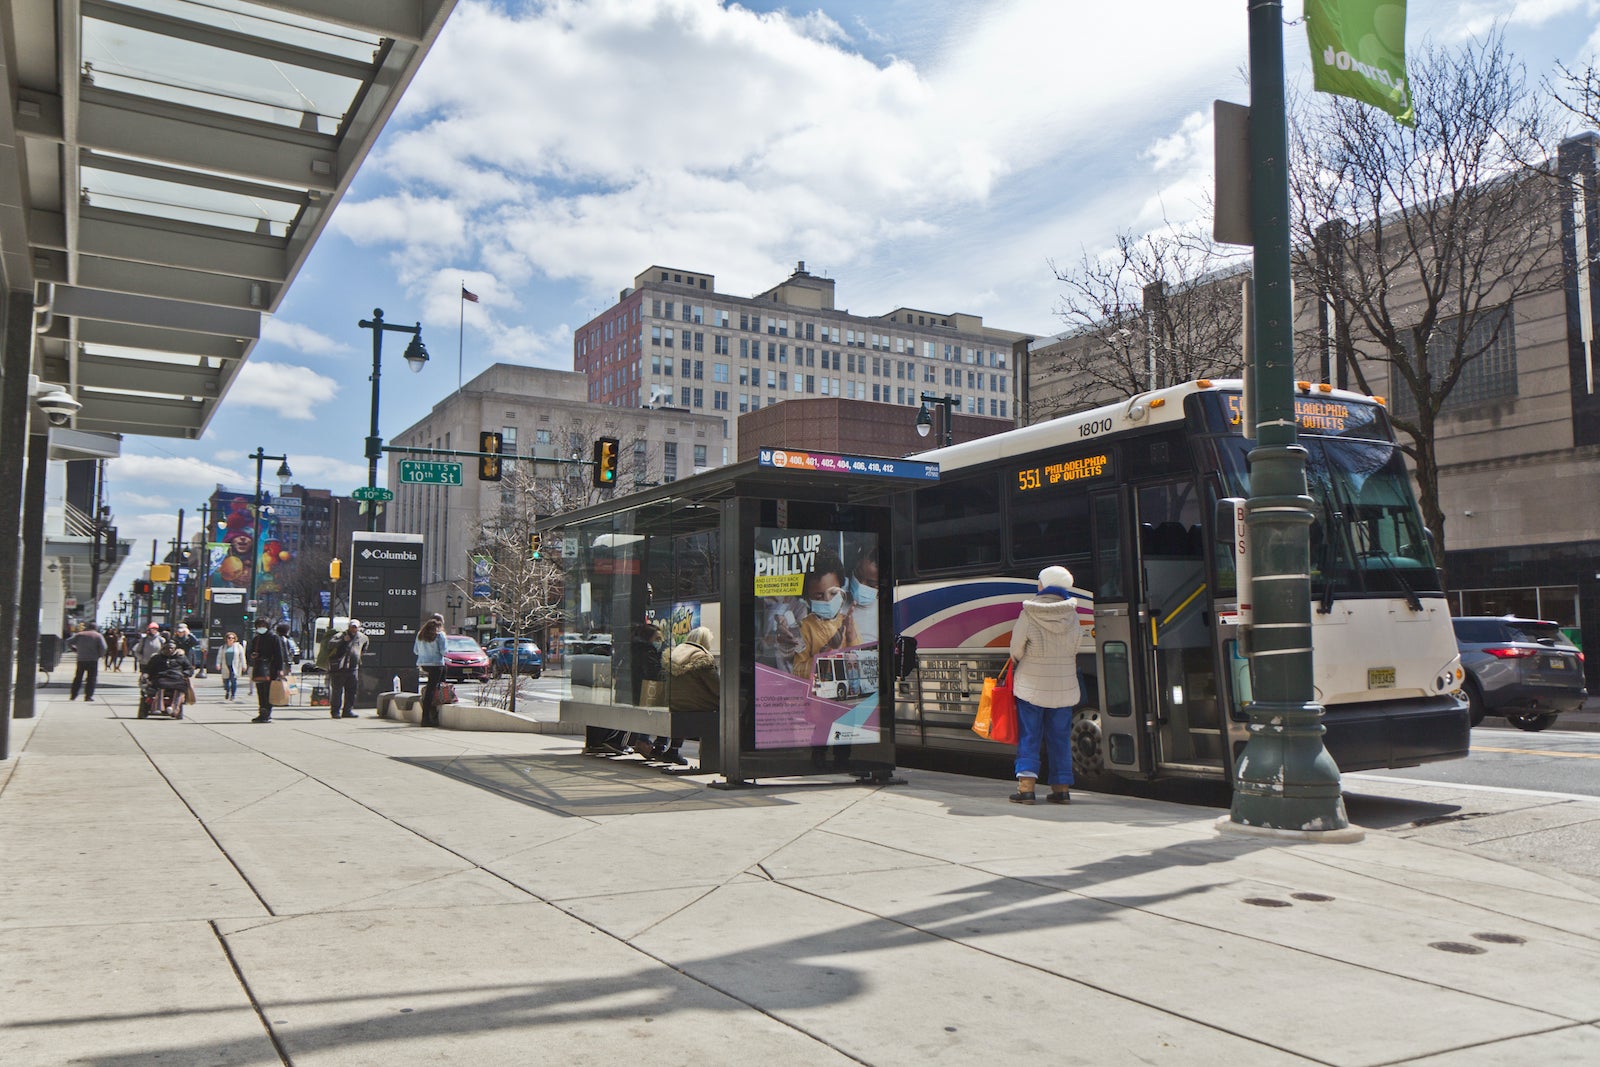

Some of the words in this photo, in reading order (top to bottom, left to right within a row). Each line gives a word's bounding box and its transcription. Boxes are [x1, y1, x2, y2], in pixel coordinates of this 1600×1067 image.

[1295, 403, 1348, 418] ILADELPHIA
[1078, 418, 1113, 437] 18010
[1303, 415, 1344, 430] OUTLETS
[882, 464, 894, 473] 412
[1045, 455, 1107, 475] PHILADELPHIA
[409, 471, 433, 482] 10th
[440, 473, 454, 483] St
[1019, 468, 1041, 490] 551
[1049, 475, 1061, 484] GP
[1063, 466, 1102, 481] OUTLETS
[382, 492, 392, 500] St
[1237, 508, 1246, 554] BUS
[772, 537, 800, 556] VAX
[803, 534, 821, 553] UP,
[372, 549, 417, 560] Columbia
[755, 552, 815, 578] PHILLY!
[388, 588, 417, 596] GUESS
